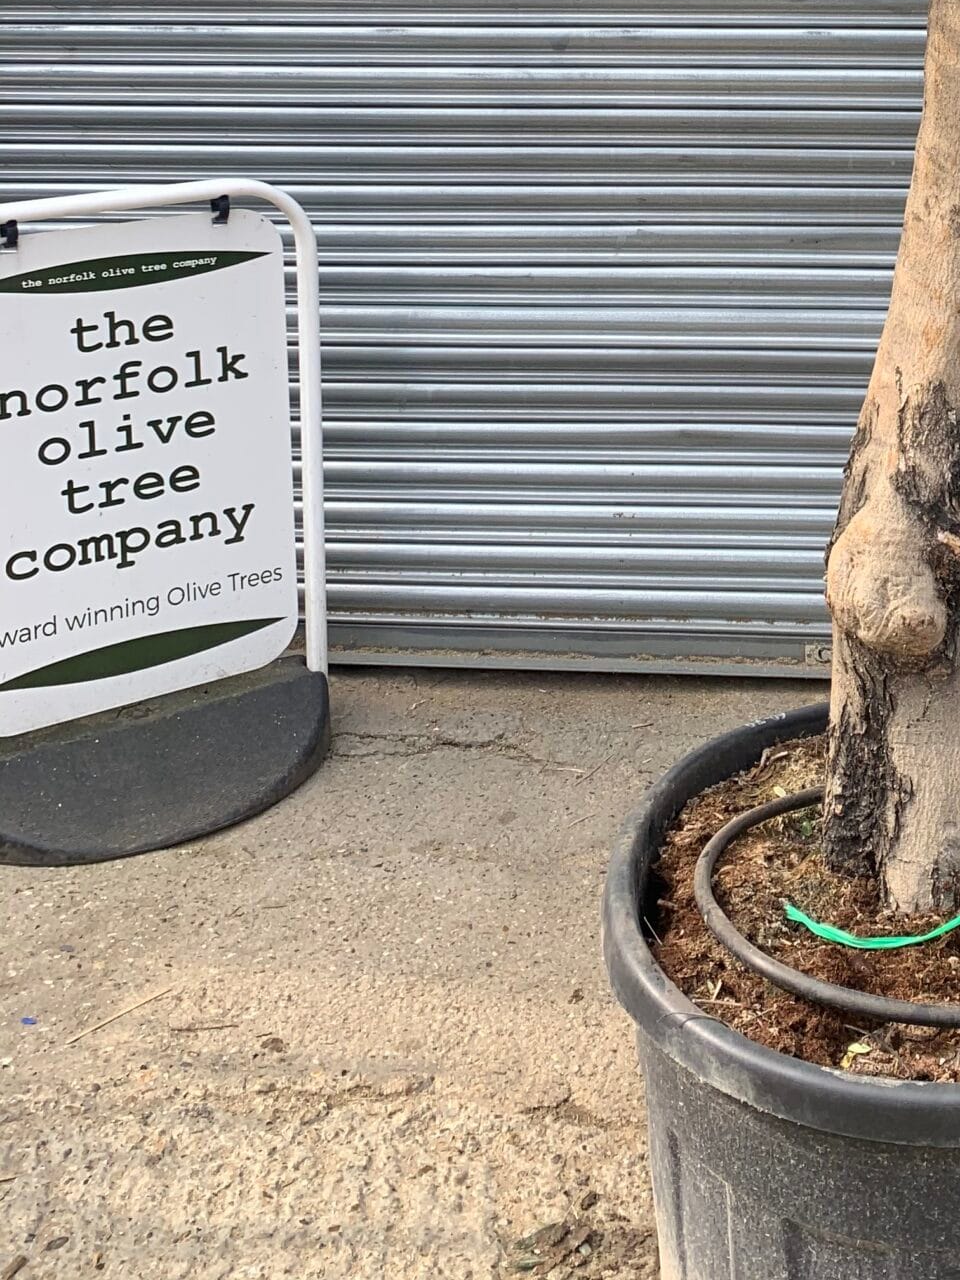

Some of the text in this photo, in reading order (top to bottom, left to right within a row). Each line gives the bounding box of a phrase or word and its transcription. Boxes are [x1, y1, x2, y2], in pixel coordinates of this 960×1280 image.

[21, 255, 218, 289] the norfolk olive tree company
[70, 311, 174, 353] the
[0, 346, 249, 419] norfolk
[38, 411, 216, 466] olive
[61, 465, 200, 514] tree
[5, 503, 255, 581] company
[0, 567, 283, 648] ward winning Olive Trees
